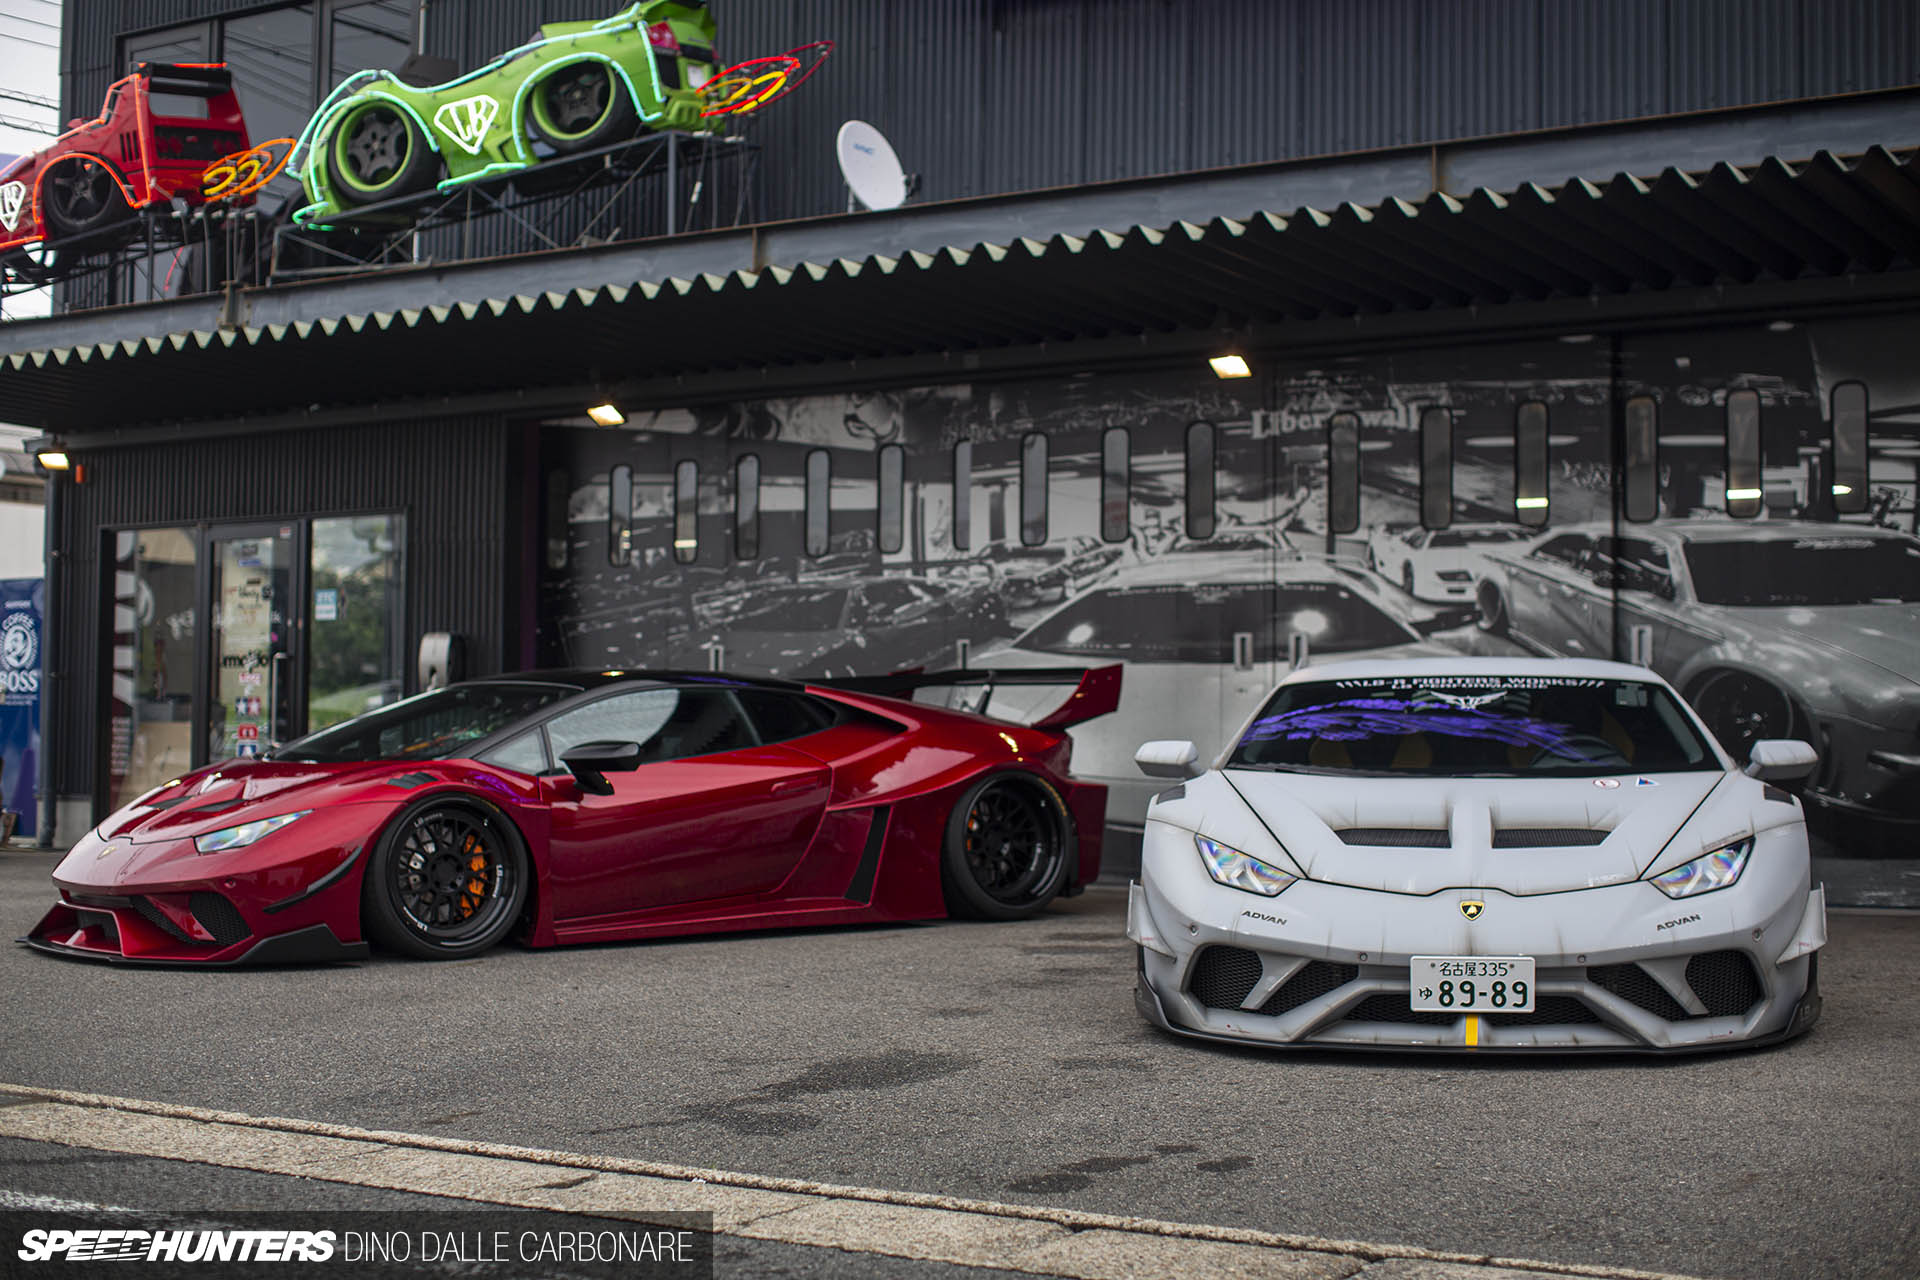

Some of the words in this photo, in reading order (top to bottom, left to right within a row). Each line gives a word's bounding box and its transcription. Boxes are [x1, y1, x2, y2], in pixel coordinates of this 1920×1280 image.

[1242, 910, 1287, 926] ADVAN
[1656, 913, 1702, 932] ADVAN
[1418, 986, 1433, 1001] ゆ
[1438, 980, 1529, 1009] 89-89
